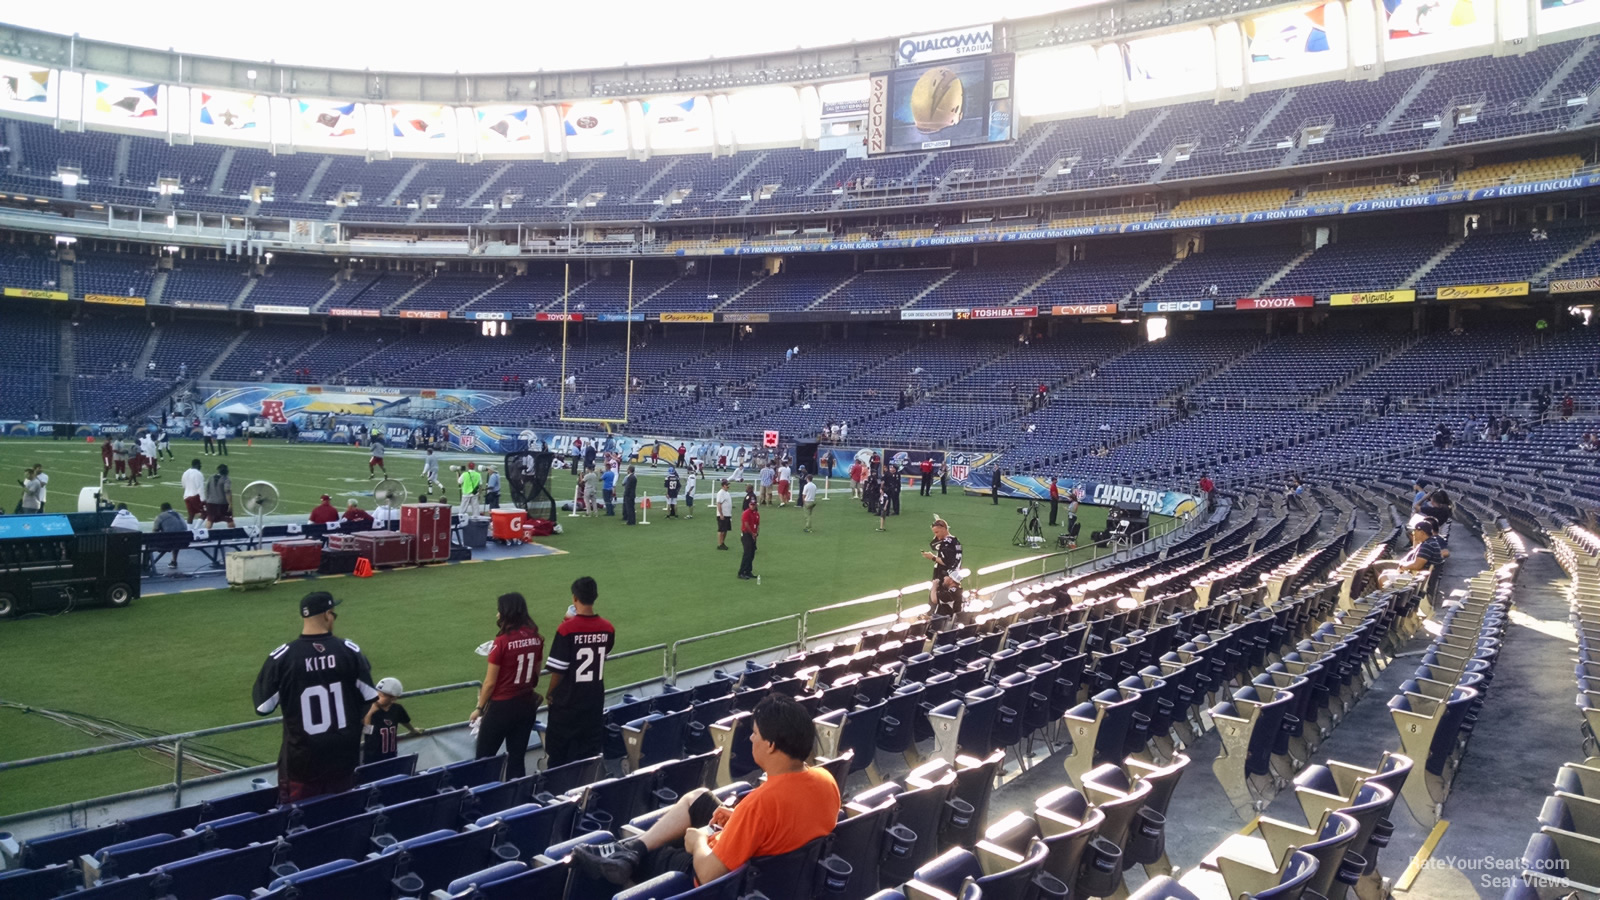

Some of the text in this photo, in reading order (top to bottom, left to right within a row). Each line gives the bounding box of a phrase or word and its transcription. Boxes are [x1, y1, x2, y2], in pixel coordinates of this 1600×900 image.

[899, 30, 992, 62] QUALCOMM
[956, 43, 992, 55] STADIUM
[872, 79, 883, 151] SYCUAN
[1483, 189, 1495, 197] 22
[1499, 184, 1532, 196] KEITH
[1534, 178, 1582, 191] LINCOLN
[1357, 203, 1368, 211] 23
[1371, 199, 1398, 209] PAUL
[1400, 196, 1430, 206] LOWE
[1266, 211, 1288, 219] RON
[1288, 208, 1308, 217] MIX
[1143, 221, 1168, 230] LANCE
[1169, 217, 1211, 227] ALWORTH
[1018, 230, 1046, 239] JACQUE
[1047, 227, 1095, 238] MacKINNON
[855, 241, 878, 249] KARAS
[930, 237, 945, 245] BOB
[945, 235, 974, 244] LARABA
[751, 246, 772, 254] FRANK
[773, 245, 802, 253] BUNCOM
[1552, 278, 1600, 291] SYCUAN
[1157, 301, 1202, 312] GEICO
[1253, 298, 1296, 309] TOYOTA
[330, 309, 362, 317] TOSHIBA
[406, 311, 441, 319] CYMER
[475, 312, 505, 320] GEICO
[975, 309, 1013, 317] TOSHIBA
[1060, 305, 1108, 315] CYMER
[951, 465, 969, 480] NFL
[1093, 484, 1165, 512] CHARGERS
[510, 517, 522, 532] G
[354, 559, 365, 575] 40
[305, 654, 336, 673] KITO
[514, 652, 535, 684] 11
[575, 646, 606, 683] 21
[300, 681, 347, 736] 01
[943, 723, 948, 731] 5
[1079, 727, 1084, 735] 6
[1231, 727, 1236, 735] 7
[1409, 723, 1417, 733] 8
[380, 725, 397, 755] 11
